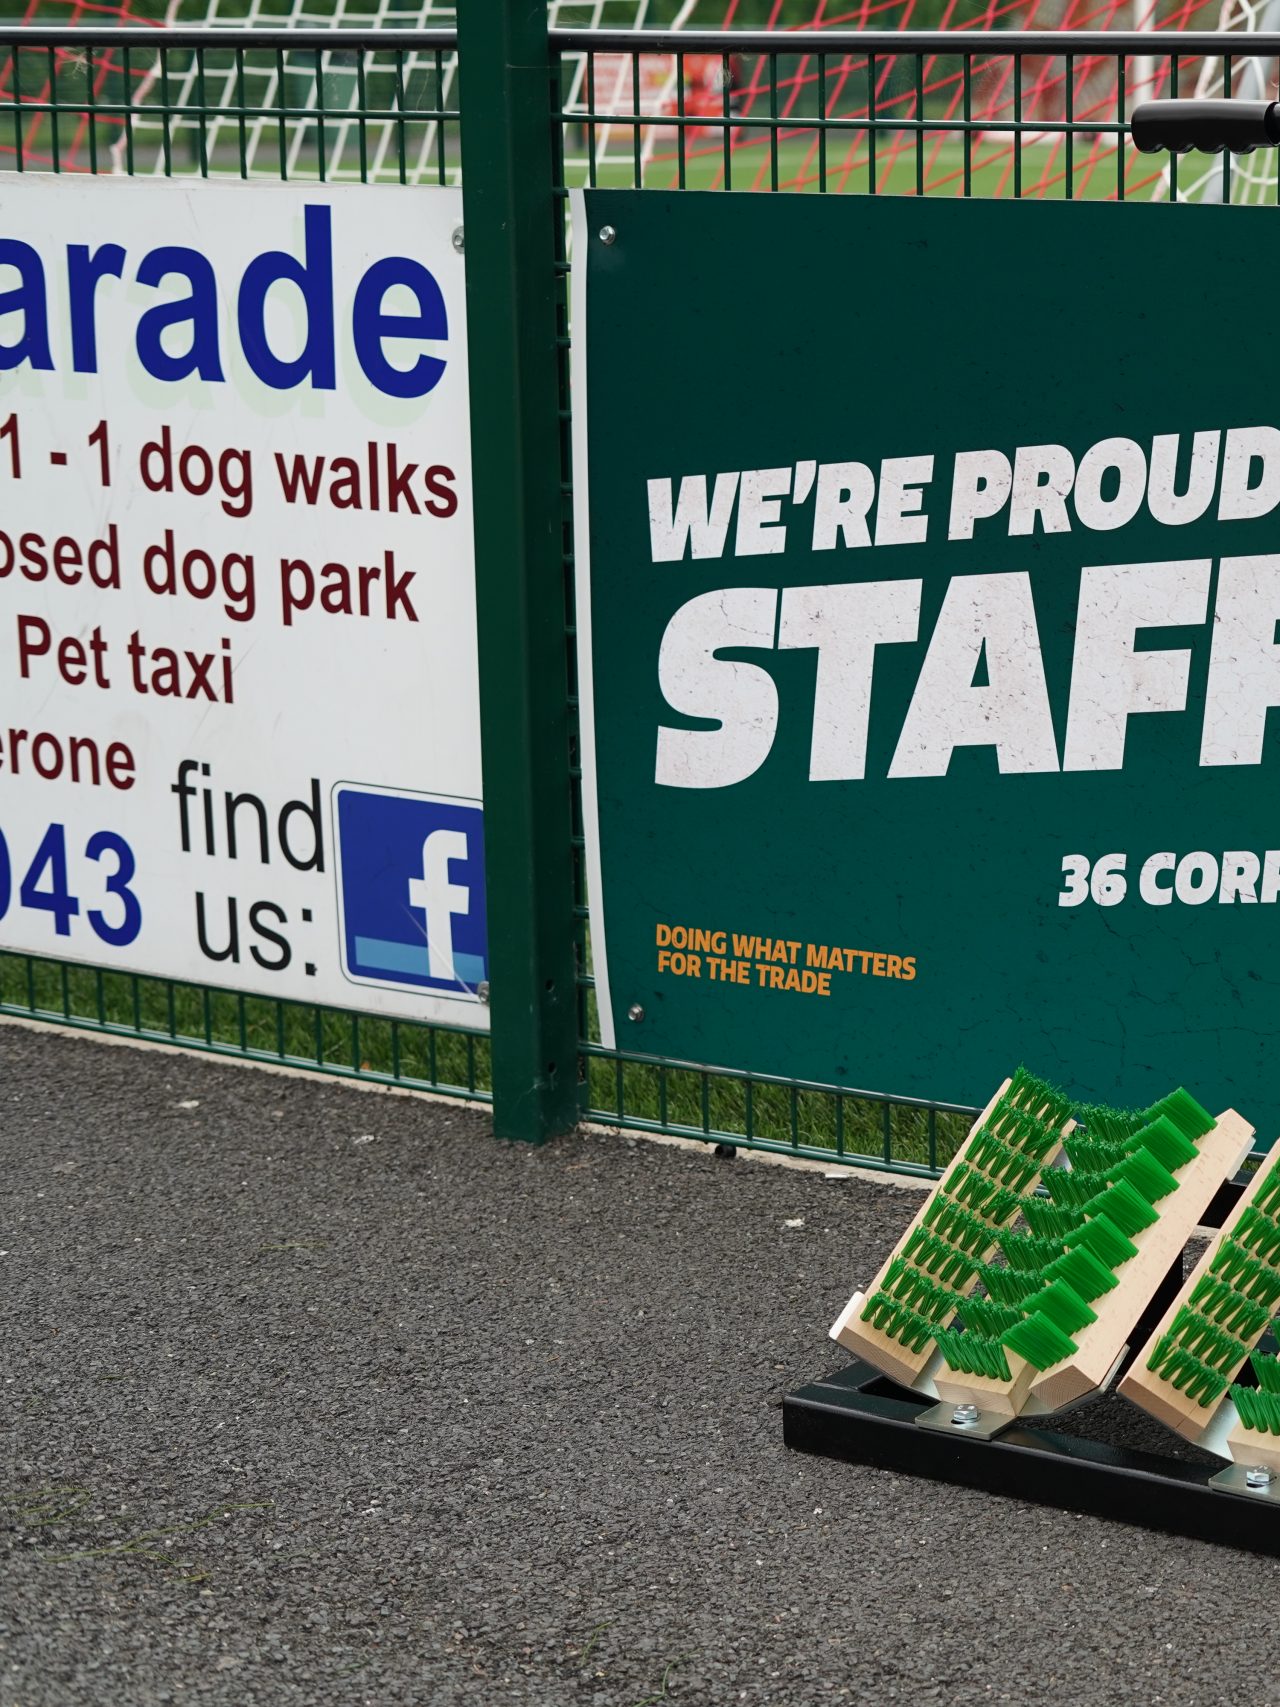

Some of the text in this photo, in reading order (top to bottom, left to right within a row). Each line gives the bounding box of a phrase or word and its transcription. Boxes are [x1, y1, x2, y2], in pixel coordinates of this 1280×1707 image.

[88, 420, 111, 487] 1
[140, 425, 252, 518] dog
[275, 442, 457, 517] walks
[647, 455, 934, 562] WE'RE
[143, 529, 256, 621] dog
[280, 550, 419, 625] park
[18, 615, 234, 703] Pet taxi
[0, 728, 136, 790] rone
[171, 759, 325, 873] find
[0, 823, 142, 947] 43
[1059, 854, 1127, 906] 36
[195, 891, 317, 976] us:
[656, 924, 916, 980] DOING WHAT MATTERS
[658, 950, 832, 996] FOR THE TRADE
